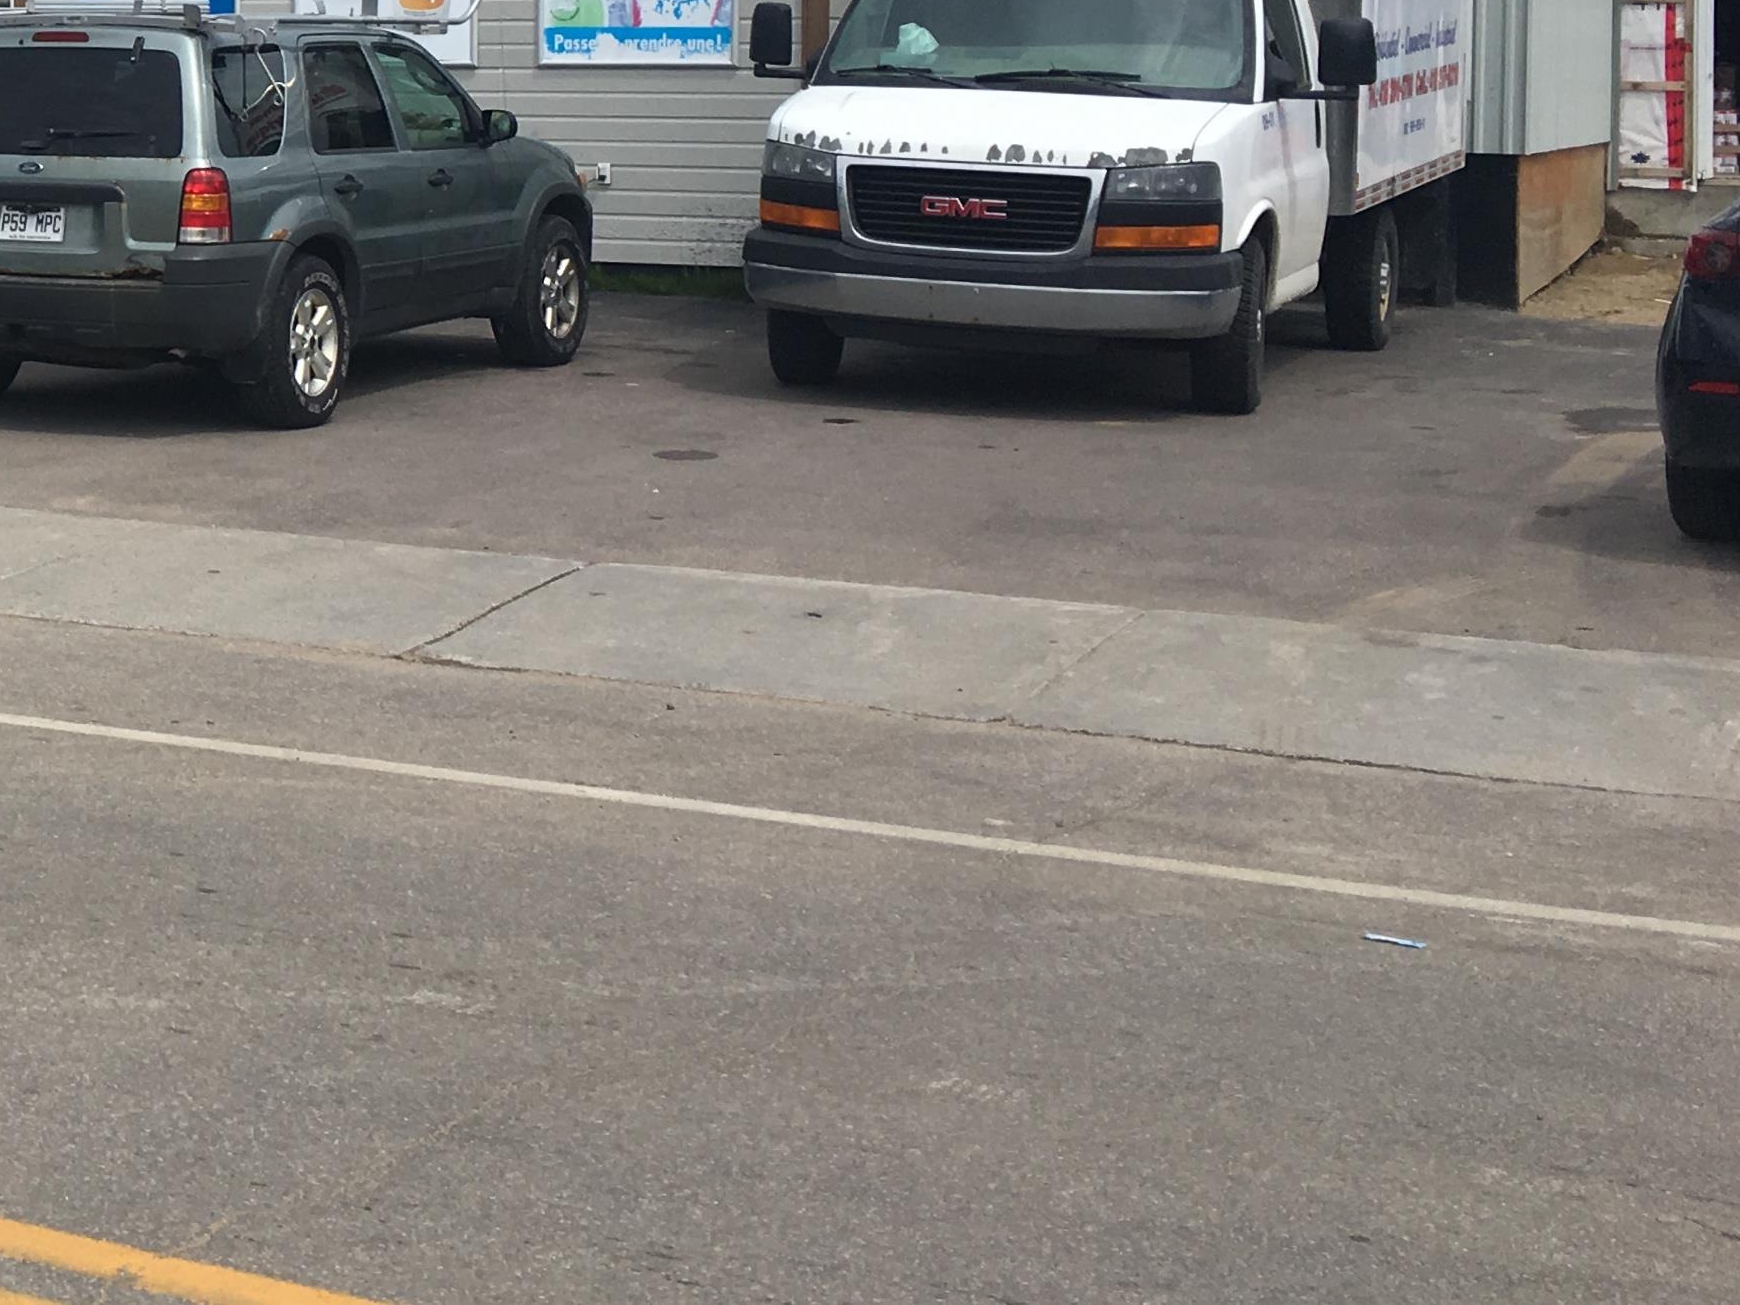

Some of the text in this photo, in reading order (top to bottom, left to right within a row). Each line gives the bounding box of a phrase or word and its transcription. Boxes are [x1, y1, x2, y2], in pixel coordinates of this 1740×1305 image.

[554, 34, 596, 51] Passe
[921, 196, 1008, 219] GMC
[1, 213, 62, 233] P59 MPC
